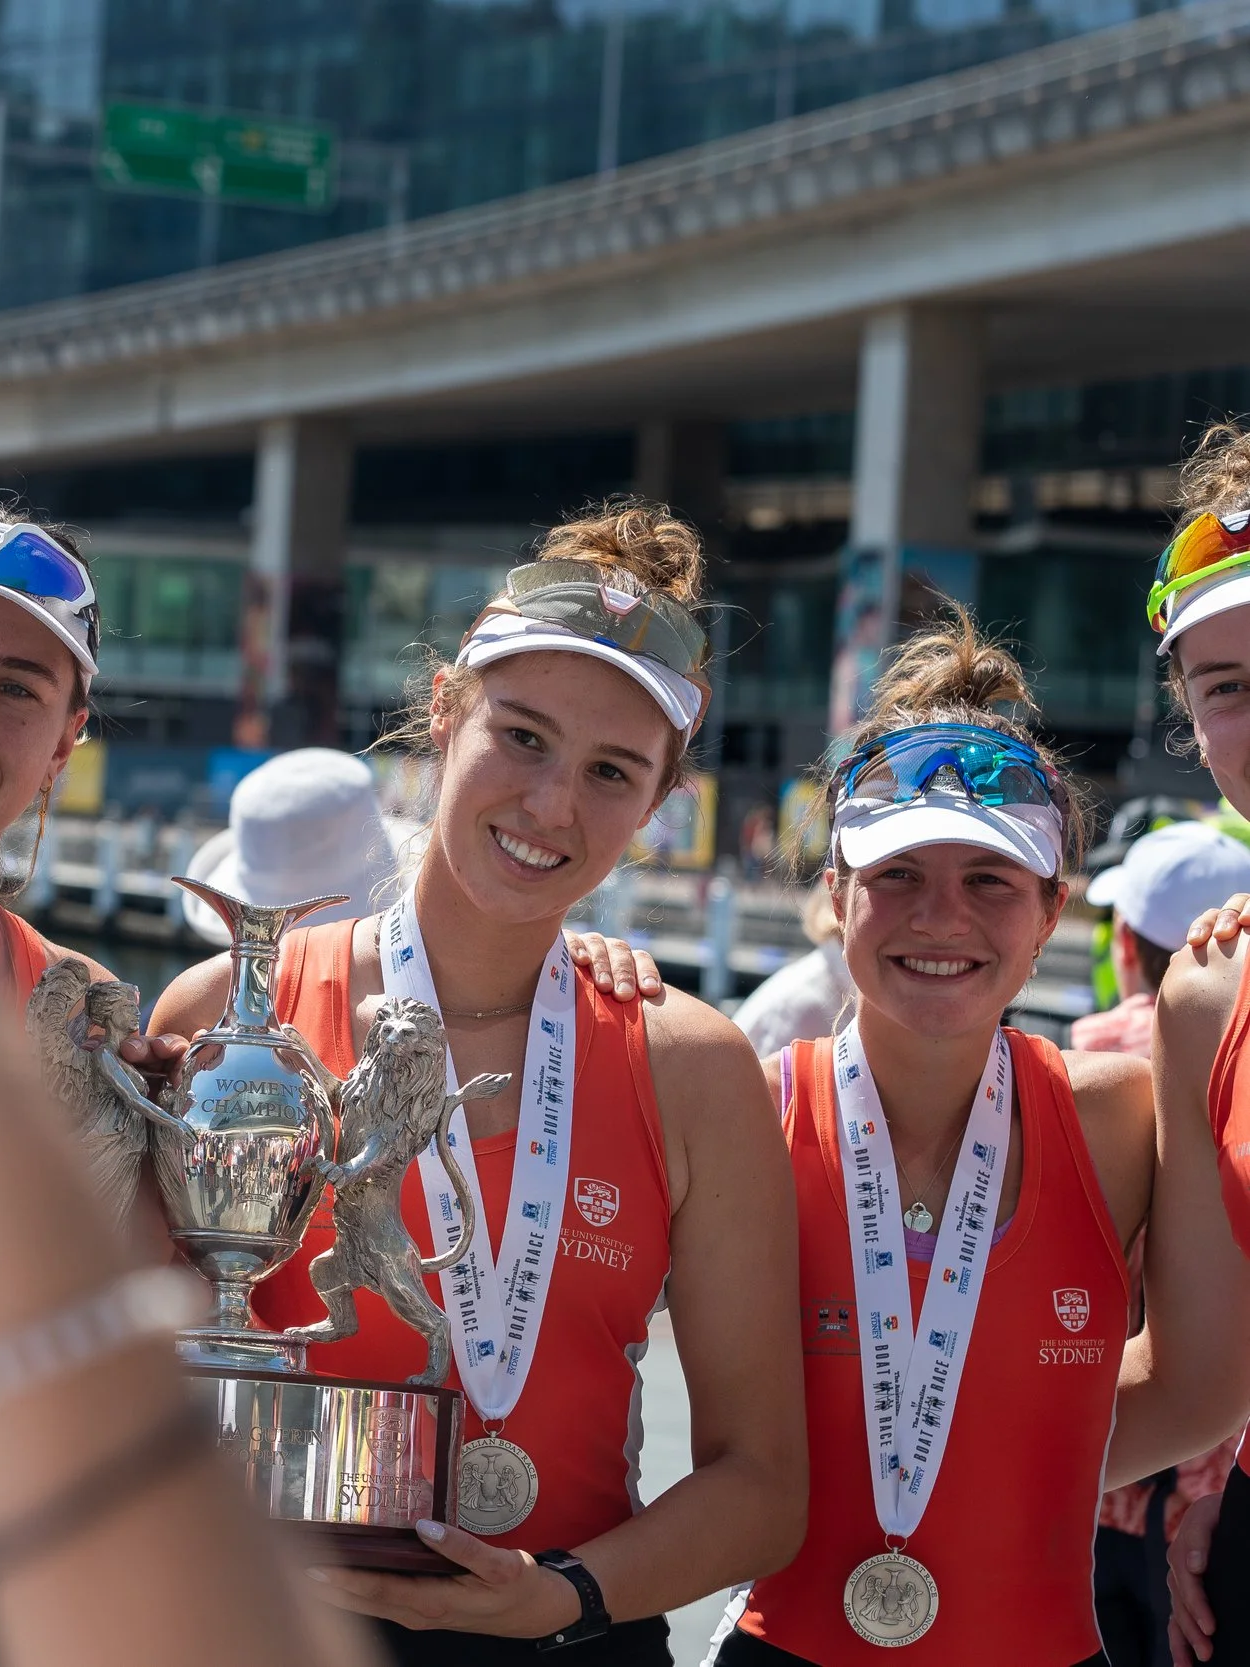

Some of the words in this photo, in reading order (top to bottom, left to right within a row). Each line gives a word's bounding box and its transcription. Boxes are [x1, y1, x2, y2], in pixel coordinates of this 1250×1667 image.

[390, 917, 402, 946] RACE
[548, 1044, 562, 1074] RACE
[996, 1056, 1006, 1086] BOAT
[215, 1078, 307, 1100] WOMEN'S
[544, 1106, 558, 1136] BOAT
[848, 1121, 857, 1145] SYDNEY
[550, 1140, 558, 1166] SYDNEY
[854, 1148, 872, 1176] BOAT
[439, 1192, 450, 1222] SYDNEY
[876, 1184, 884, 1214] Australian
[958, 1191, 970, 1221] Australian
[862, 1214, 879, 1244] RACE
[959, 1232, 978, 1263] BOAT
[974, 1169, 990, 1200] RACE
[560, 1238, 632, 1271] YDNEY
[572, 1230, 624, 1250] UNIVERSITY
[624, 1244, 634, 1253] OF
[472, 1266, 482, 1300] Australian
[508, 1306, 528, 1340] BOAT
[524, 1232, 544, 1266] RACE
[510, 1259, 520, 1294] Australian
[960, 1268, 972, 1295] SYDNEY
[460, 1300, 478, 1334] RACE
[870, 1312, 880, 1340] SYDNEY
[510, 1346, 522, 1376] SYDNEY
[875, 1344, 890, 1375] BOAT
[1038, 1348, 1104, 1364] SYDNEY
[914, 1429, 934, 1462] BOAT
[930, 1360, 950, 1392] RACE
[915, 1384, 926, 1419] Australian
[250, 1426, 323, 1446] GUERIN
[879, 1416, 892, 1447] RACE
[498, 1440, 524, 1455] BOAT
[522, 1455, 537, 1480] RACE
[341, 1472, 360, 1482] THE
[911, 1467, 925, 1495] SYDNEY
[339, 1484, 422, 1510] SYDNEY
[458, 1517, 491, 1534] OMEN'S
[850, 1554, 900, 1586] AUSTRALIAN
[902, 1555, 926, 1574] BOAT
[924, 1572, 938, 1598] RACE
[844, 1602, 854, 1620] 2022
[852, 1620, 888, 1646] WOMEN'S
[890, 1614, 934, 1646] CHAMPIONS
